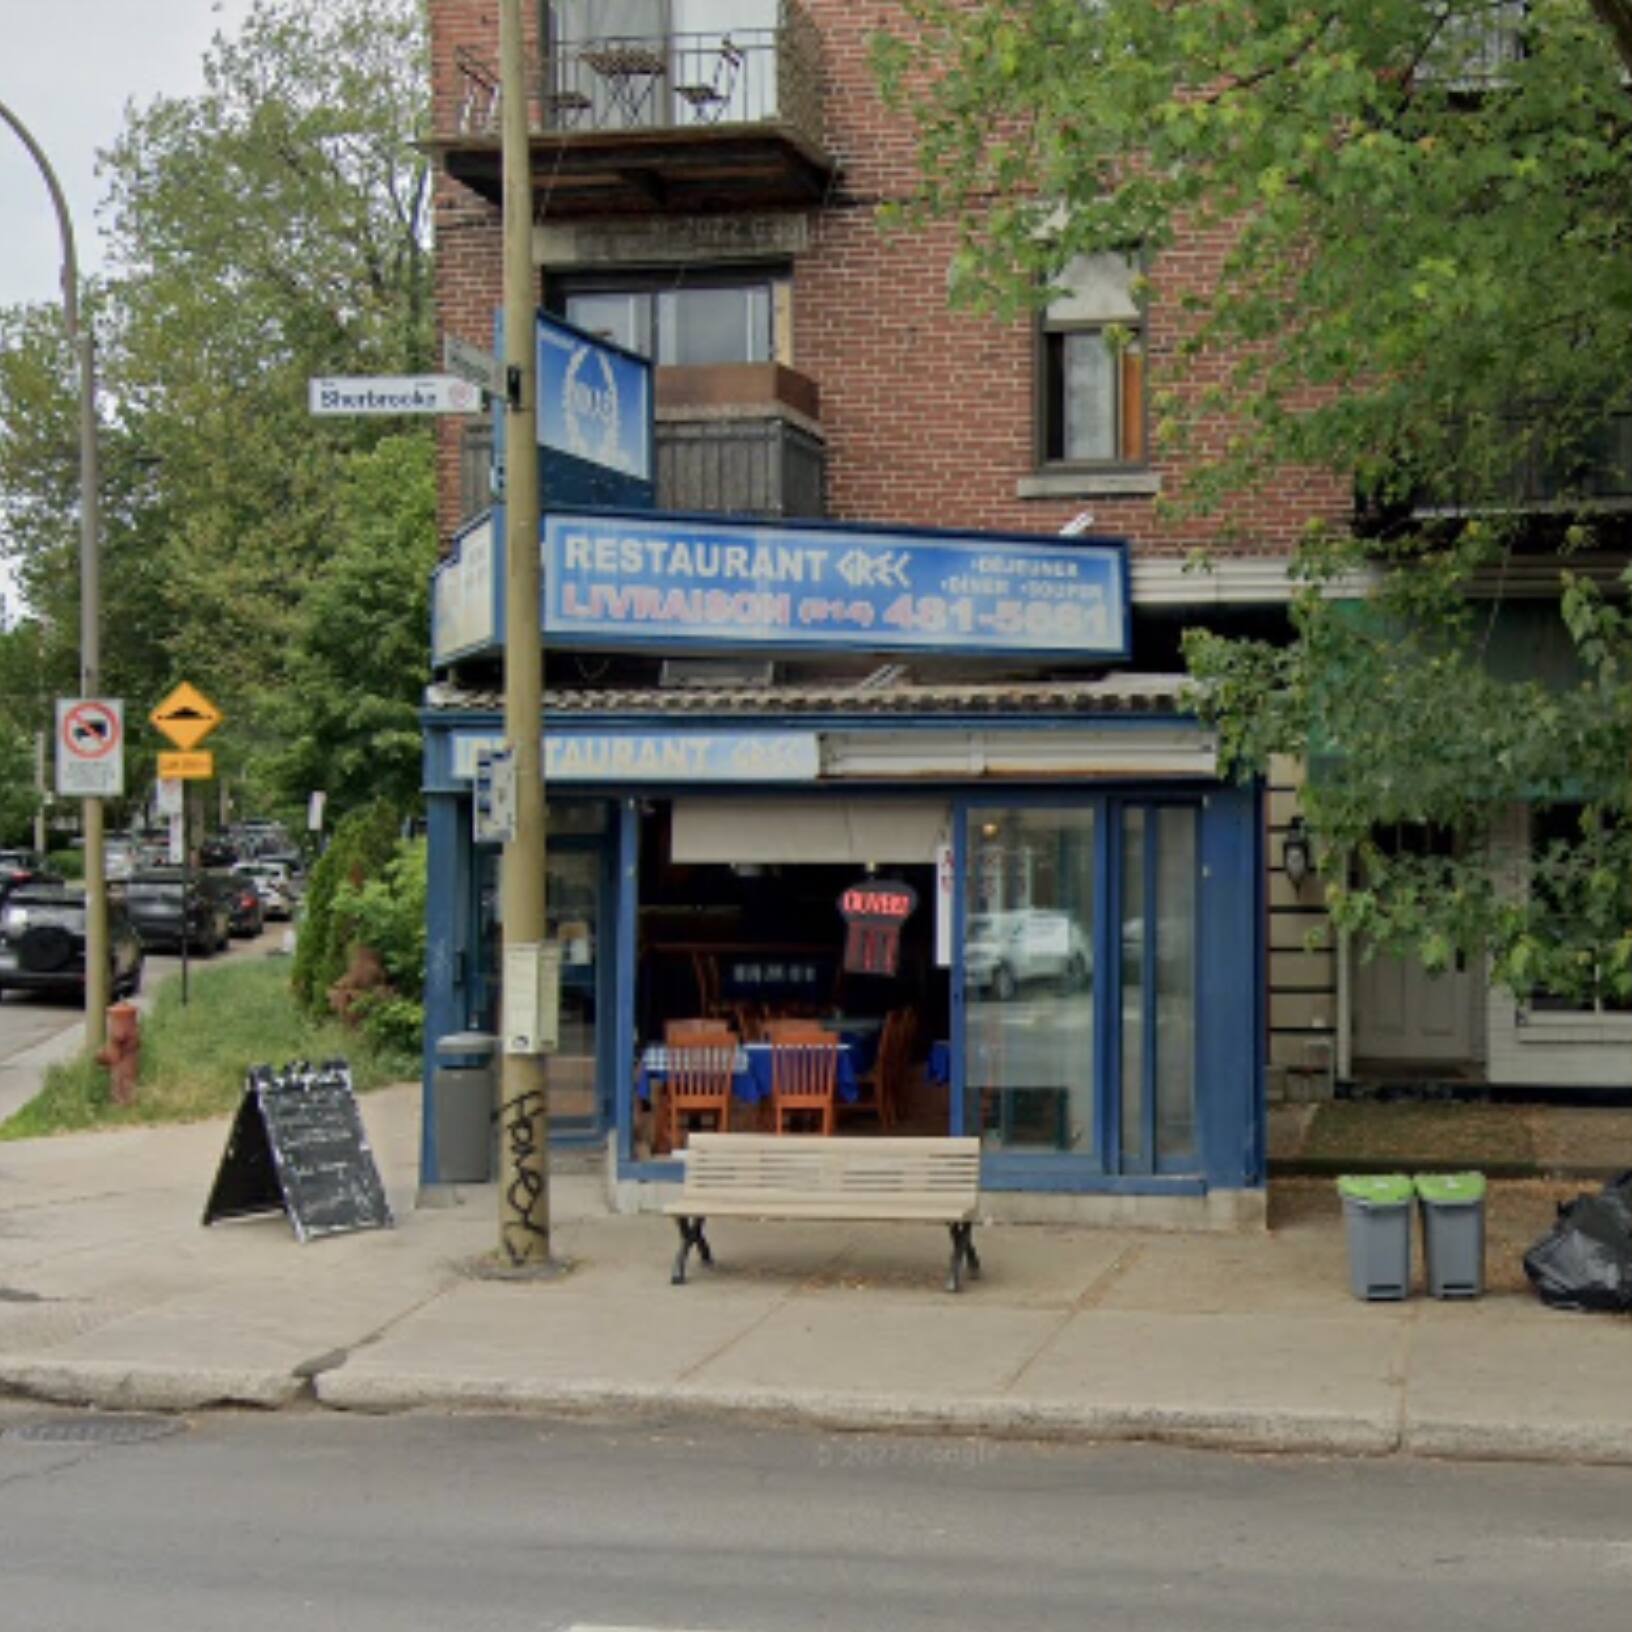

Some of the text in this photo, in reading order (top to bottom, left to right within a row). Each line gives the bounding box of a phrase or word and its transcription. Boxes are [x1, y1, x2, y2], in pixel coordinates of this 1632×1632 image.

[320, 389, 437, 409] Sherbrooke
[564, 534, 829, 583] RESTAURANT
[562, 582, 790, 627] LIVRAISON
[471, 735, 711, 773] TAURANT
